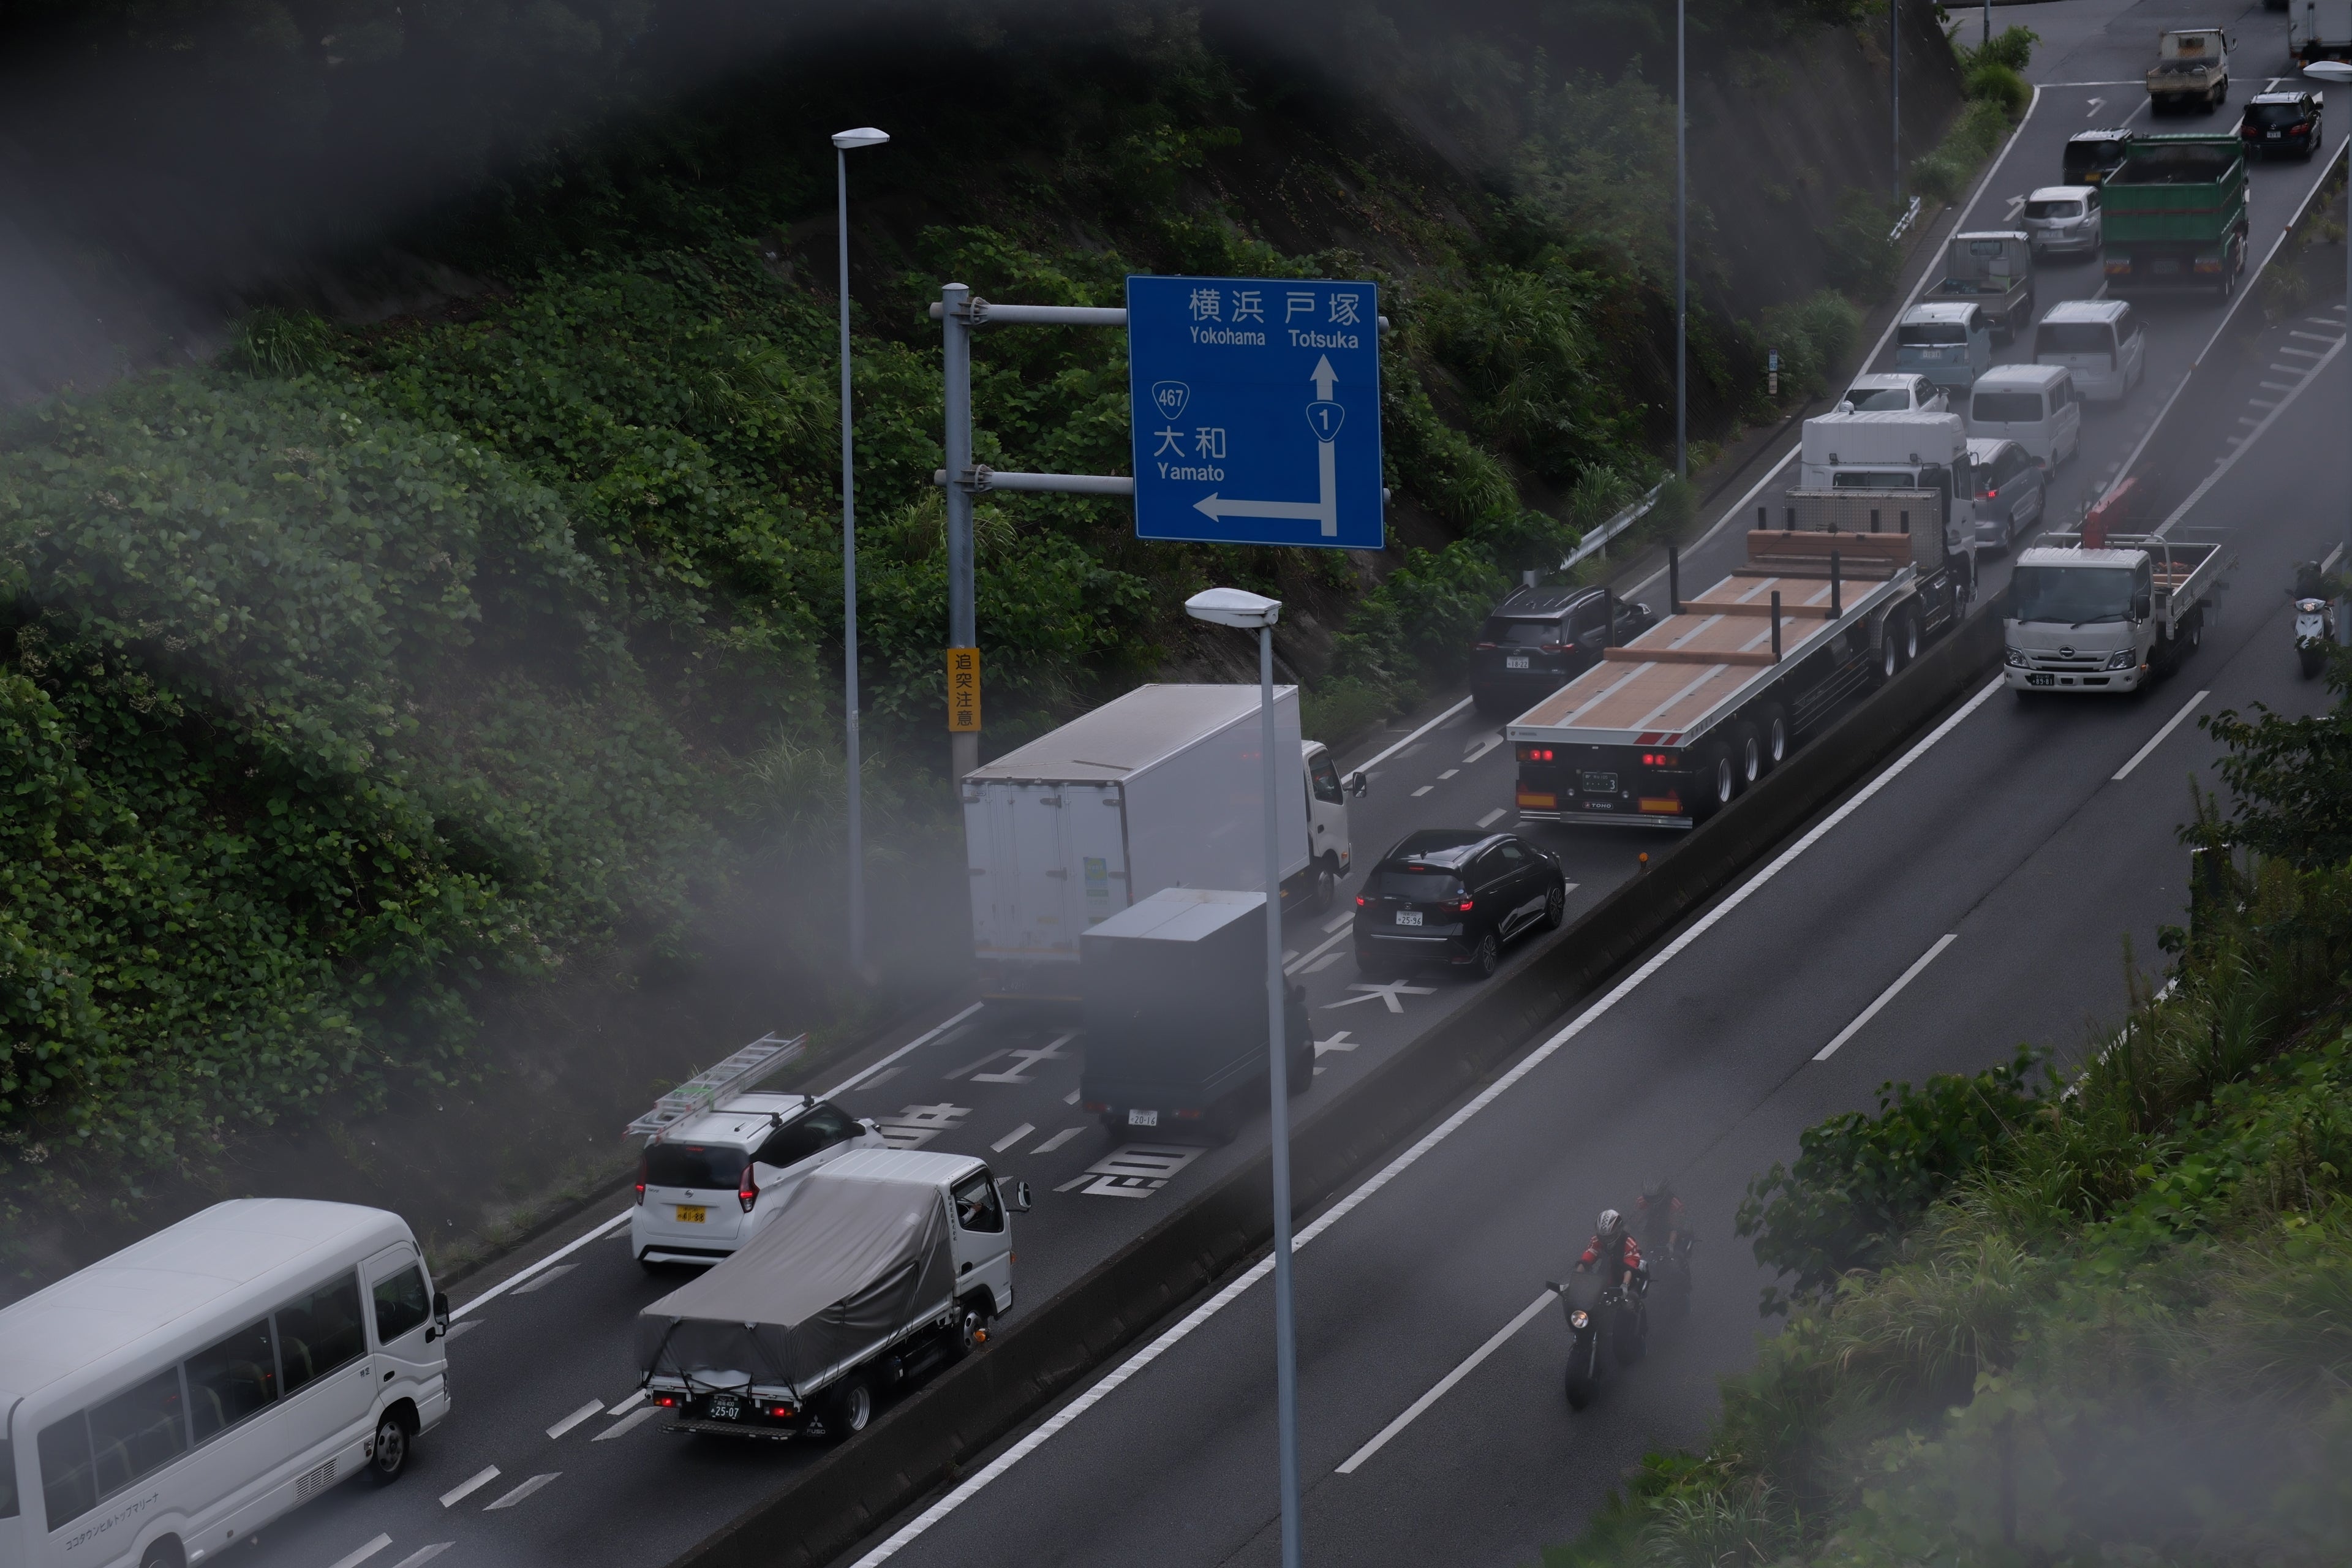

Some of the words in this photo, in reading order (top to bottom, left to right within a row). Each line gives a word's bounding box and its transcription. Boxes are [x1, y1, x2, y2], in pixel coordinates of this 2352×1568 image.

[1189, 288, 1264, 323] 横浜
[1285, 292, 1360, 326] 戸塚
[1190, 326, 1265, 345] Yokohama
[1288, 330, 1359, 349] Totsuka
[1159, 388, 1183, 407] 467
[1319, 409, 1329, 430] 1
[1154, 426, 1226, 459] 大和
[1158, 462, 1224, 481] Yamato
[956, 654, 973, 726] 追突注意
